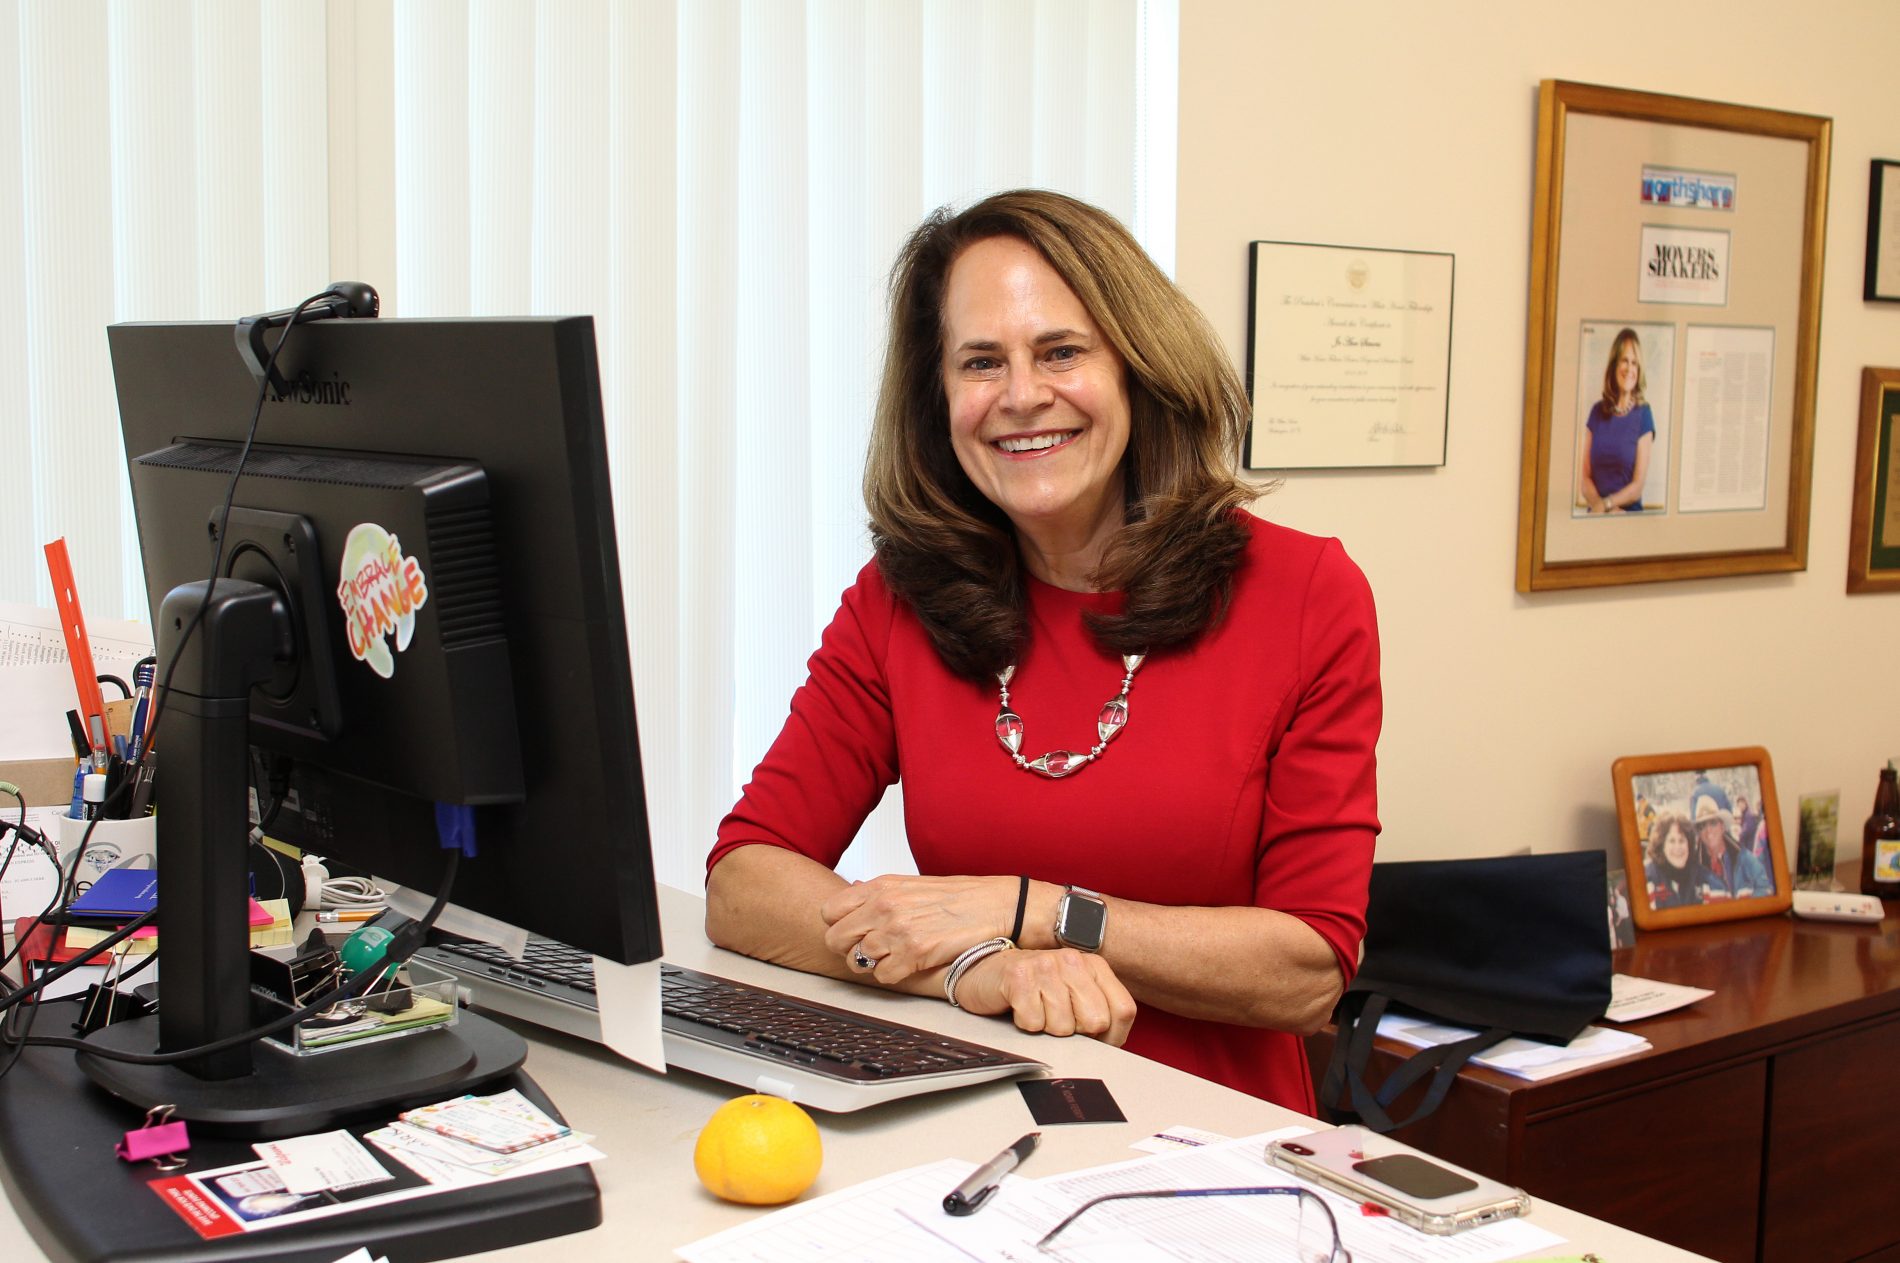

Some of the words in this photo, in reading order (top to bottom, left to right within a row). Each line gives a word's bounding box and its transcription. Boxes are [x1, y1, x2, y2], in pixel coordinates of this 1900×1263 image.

[1648, 259, 1719, 280] SHAKERS
[1655, 244, 1716, 263] MOVERS
[340, 540, 401, 616] EMBRACE
[349, 562, 425, 657] CHANGE
